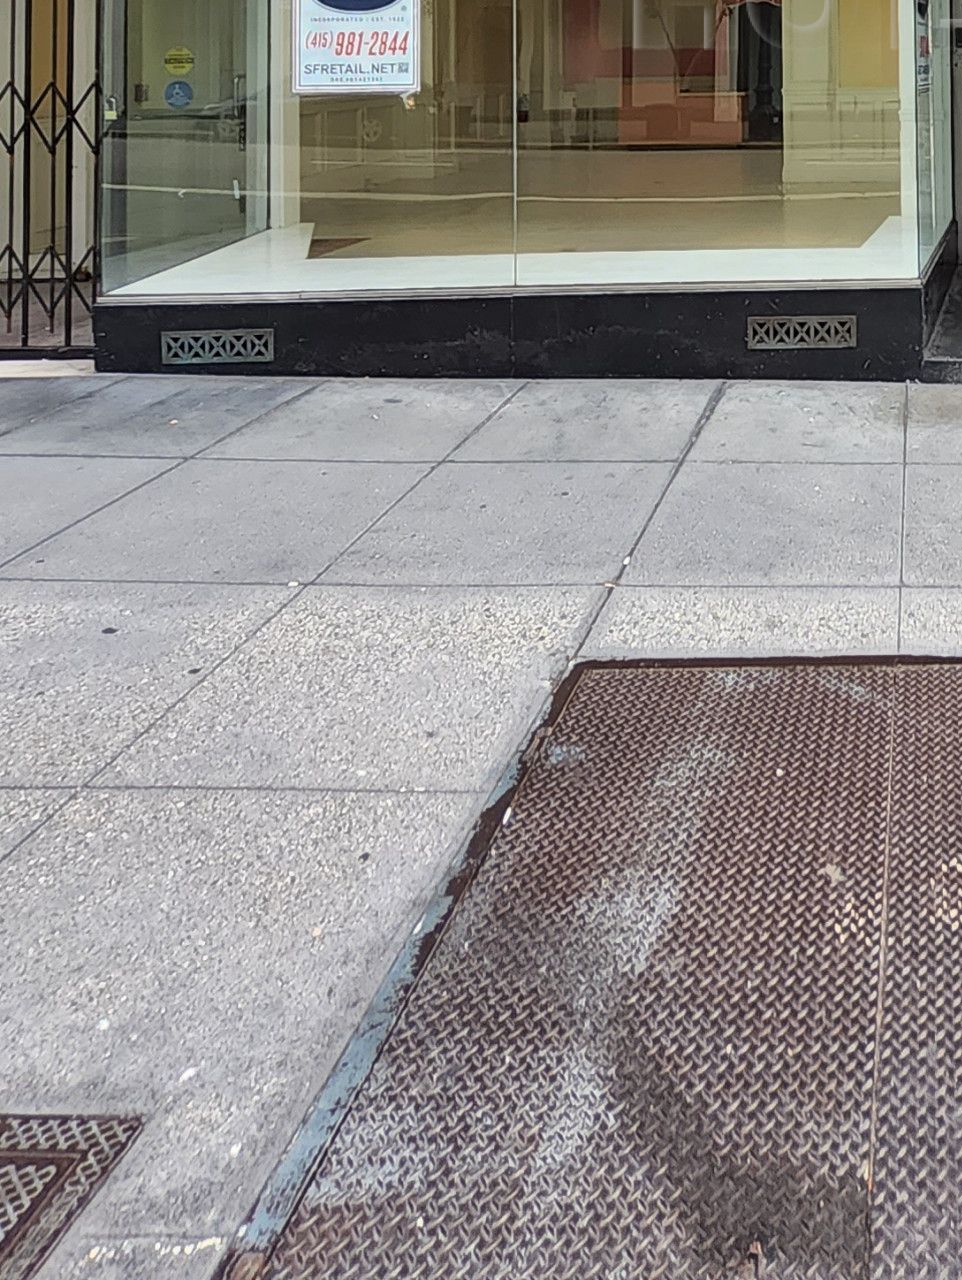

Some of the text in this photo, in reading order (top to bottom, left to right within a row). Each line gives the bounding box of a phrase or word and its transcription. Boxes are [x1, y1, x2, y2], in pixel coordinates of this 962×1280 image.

[305, 30, 410, 56] (415) 981-2844
[304, 63, 397, 75] SFRETAIL.NET
